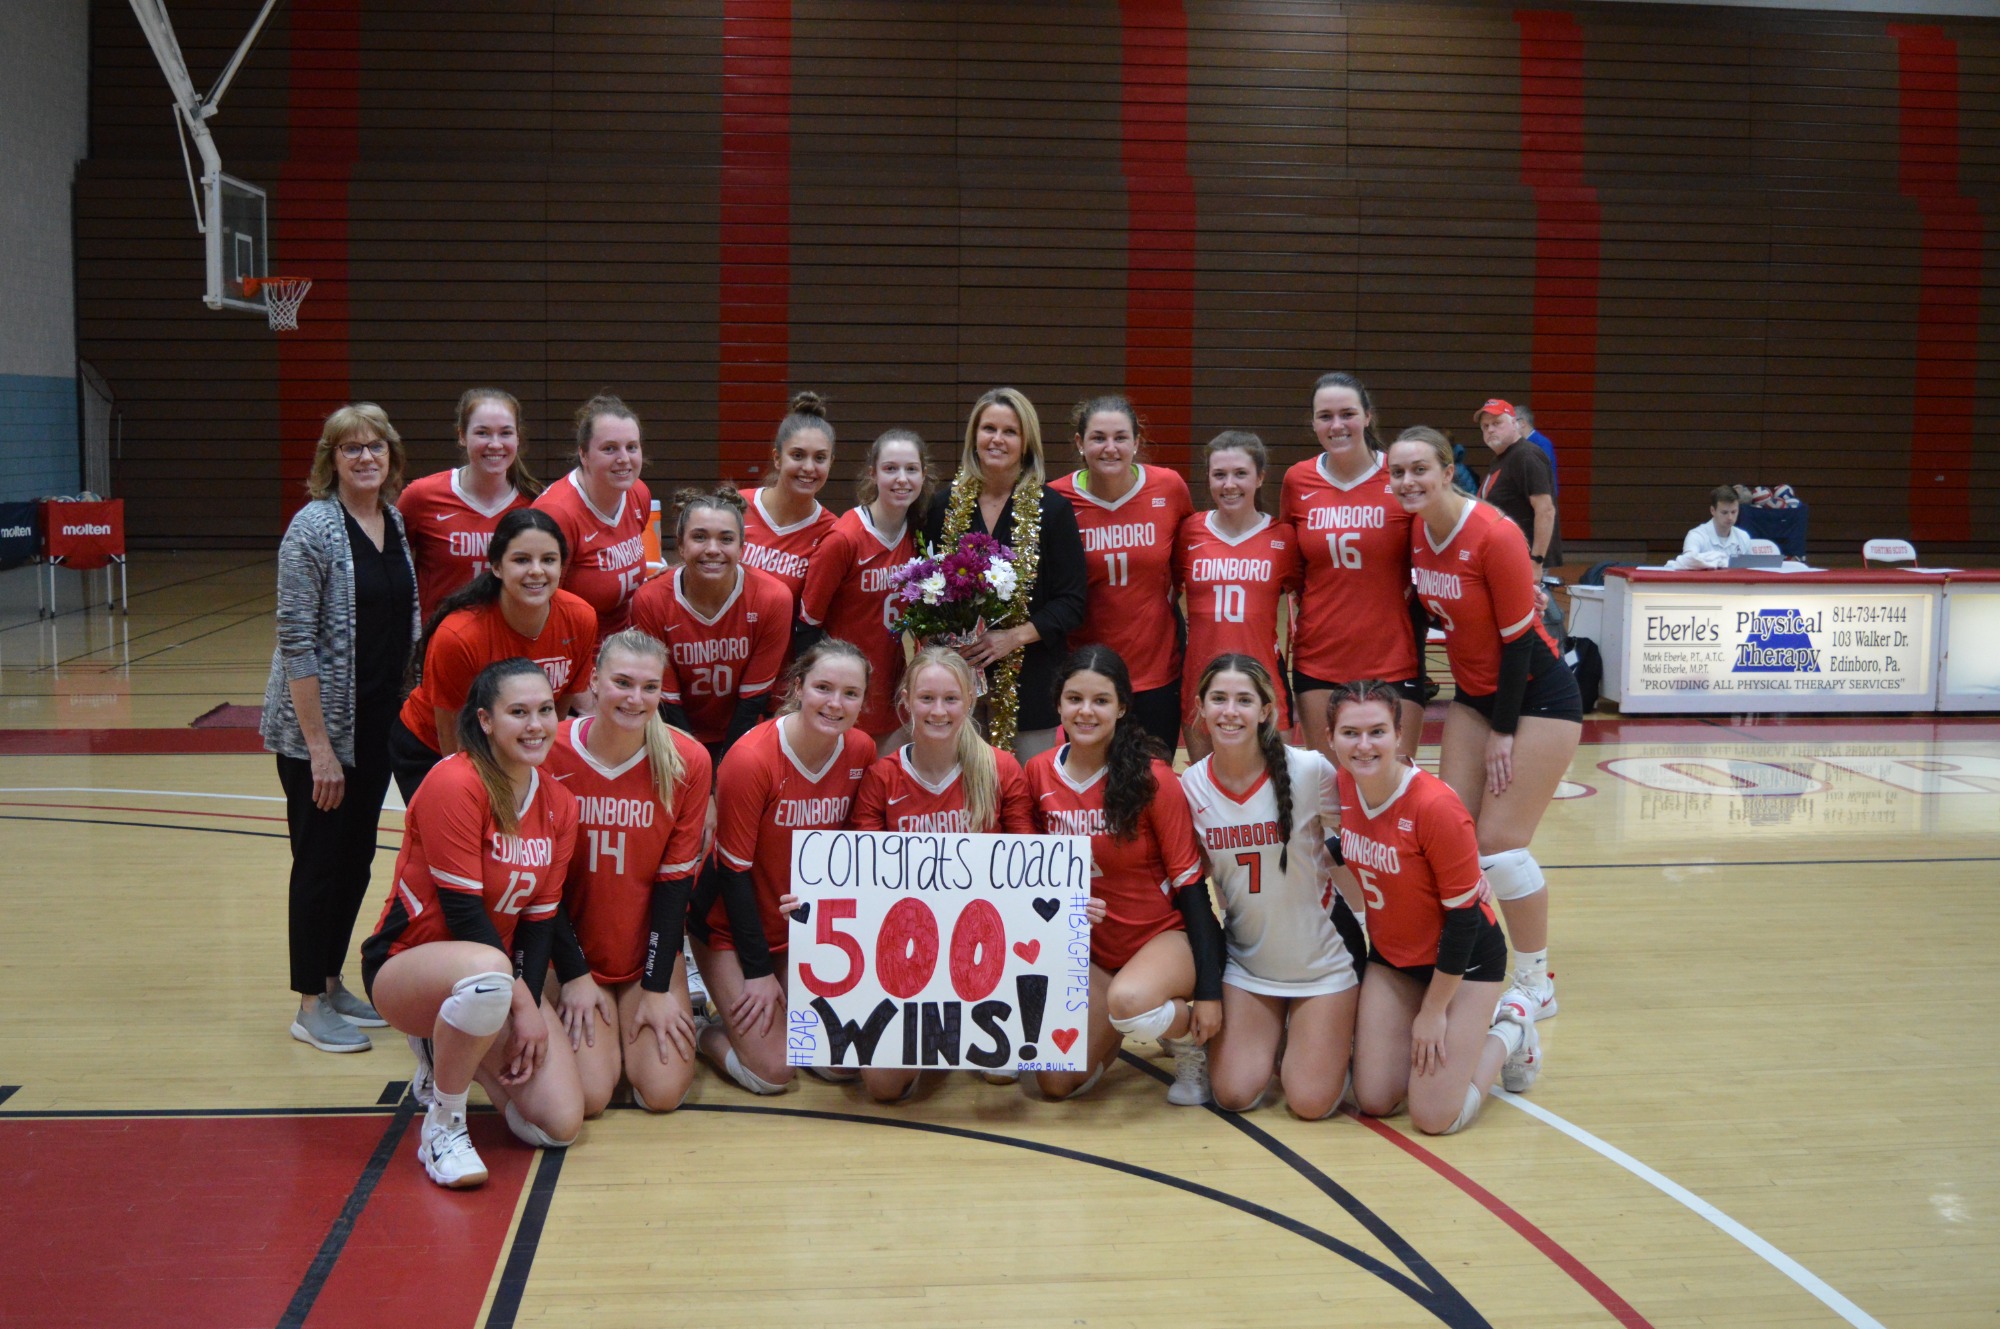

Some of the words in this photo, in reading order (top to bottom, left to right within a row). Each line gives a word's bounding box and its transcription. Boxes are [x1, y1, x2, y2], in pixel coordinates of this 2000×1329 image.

[0, 526, 31, 538] molten
[62, 524, 111, 535] molten
[1307, 506, 1384, 530] EDINBORO
[450, 531, 494, 557] EDIN
[1079, 522, 1155, 552] DINBORO
[1325, 533, 1362, 569] 16
[738, 541, 809, 578] DINBORO
[1104, 552, 1127, 586] 11
[1192, 558, 1271, 582] EDINBORO
[883, 592, 901, 631] 6
[1213, 585, 1245, 622] 10
[1832, 606, 1907, 623] 814-734-7444
[1647, 616, 1719, 641] Eberle's
[1735, 609, 1823, 640] Physical
[1832, 631, 1851, 647] 103
[1855, 631, 1891, 647] Walker
[1893, 631, 1909, 647] Dr.
[673, 636, 749, 665] EDINBORO
[1643, 652, 1662, 662] Mark
[1664, 652, 1688, 662] Eberle,
[1736, 642, 1821, 672] Therapy
[1830, 656, 1881, 674] Edinboro,
[1885, 656, 1901, 672] Pa.
[691, 664, 732, 697] 20
[1640, 679, 1709, 690] "PROVIDING
[1713, 680, 1734, 690] ALL
[1737, 680, 1791, 690] PHYSICAL
[1795, 680, 1846, 690] THERAPY
[1849, 678, 1906, 690] SERVICES"
[1642, 664, 1661, 674] Micki
[1663, 664, 1688, 674] Eberle,
[1690, 664, 1709, 674] M.P.T.
[575, 795, 654, 828] DINBORO
[774, 796, 850, 826] EDINBORO
[898, 808, 976, 833] EDINBOR
[1046, 808, 1118, 836] EDINBOR
[587, 829, 626, 875] 14
[1235, 852, 1261, 894] 7
[493, 870, 537, 915] 12
[1358, 868, 1385, 910] 5
[798, 897, 1006, 1002] 500
[1066, 892, 1089, 1011] #BAGPIPES
[810, 974, 1049, 1068] WINS!
[788, 1010, 818, 1066] #BAB
[1018, 1062, 1042, 1072] BORO
